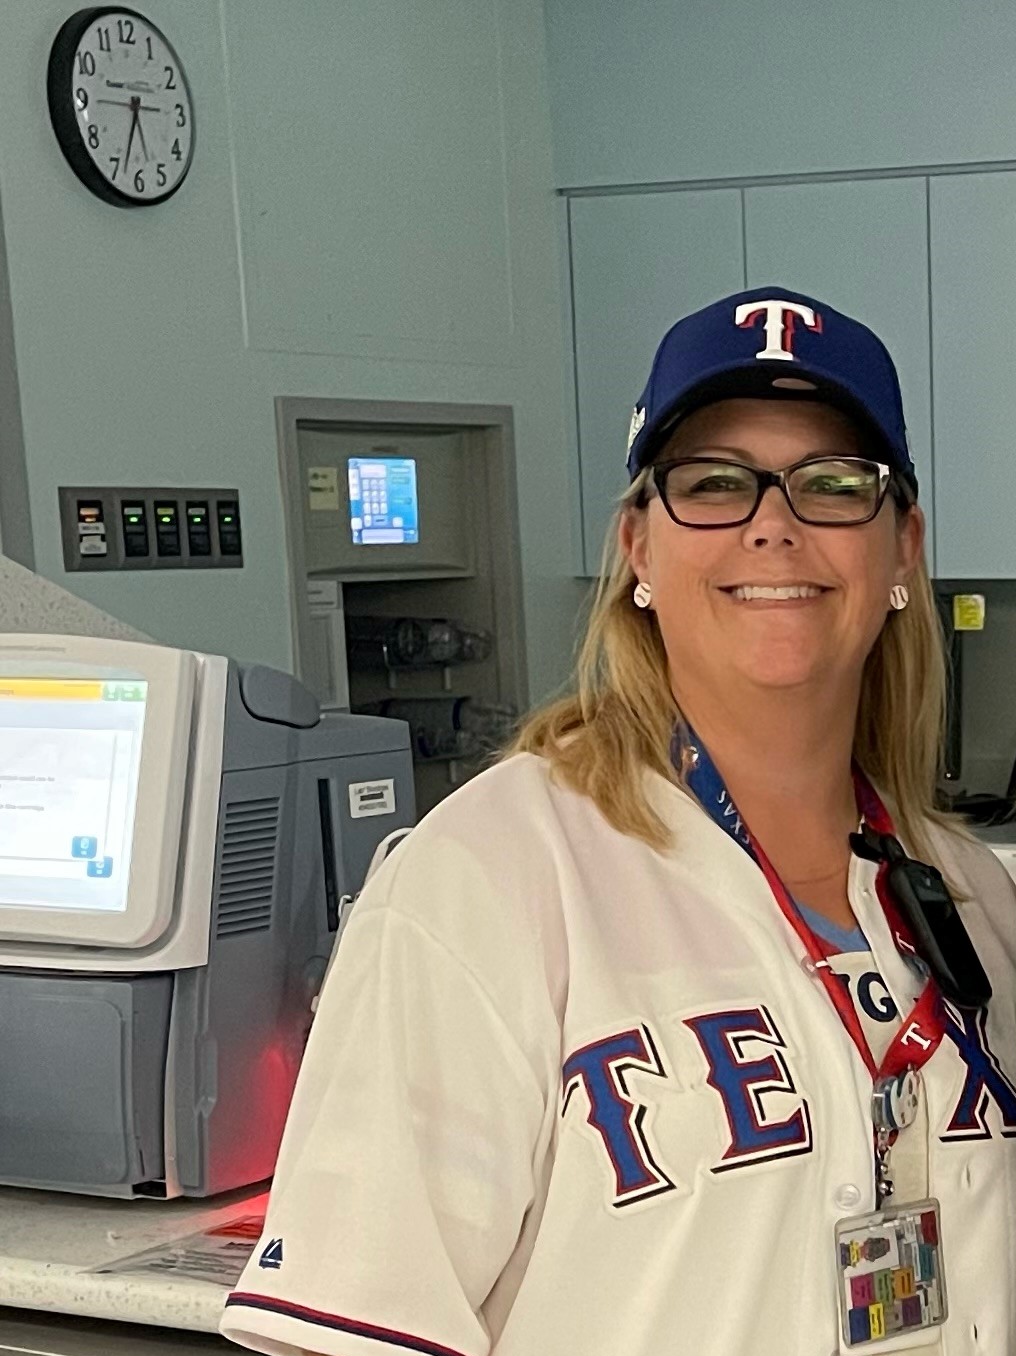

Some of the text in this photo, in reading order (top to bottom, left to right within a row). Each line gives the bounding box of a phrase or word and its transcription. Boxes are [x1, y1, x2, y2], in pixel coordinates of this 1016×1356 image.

[97, 27, 111, 52] 11
[117, 20, 136, 45] 12
[146, 37, 153, 60] 1
[78, 51, 96, 77] 10
[164, 66, 176, 90] 2
[76, 87, 88, 111] 9
[175, 104, 186, 128] 3
[88, 124, 99, 149] 8
[171, 138, 182, 161] 4
[110, 157, 120, 181] 7
[134, 169, 145, 193] 6
[156, 164, 167, 187] 5
[735, 300, 823, 360] T
